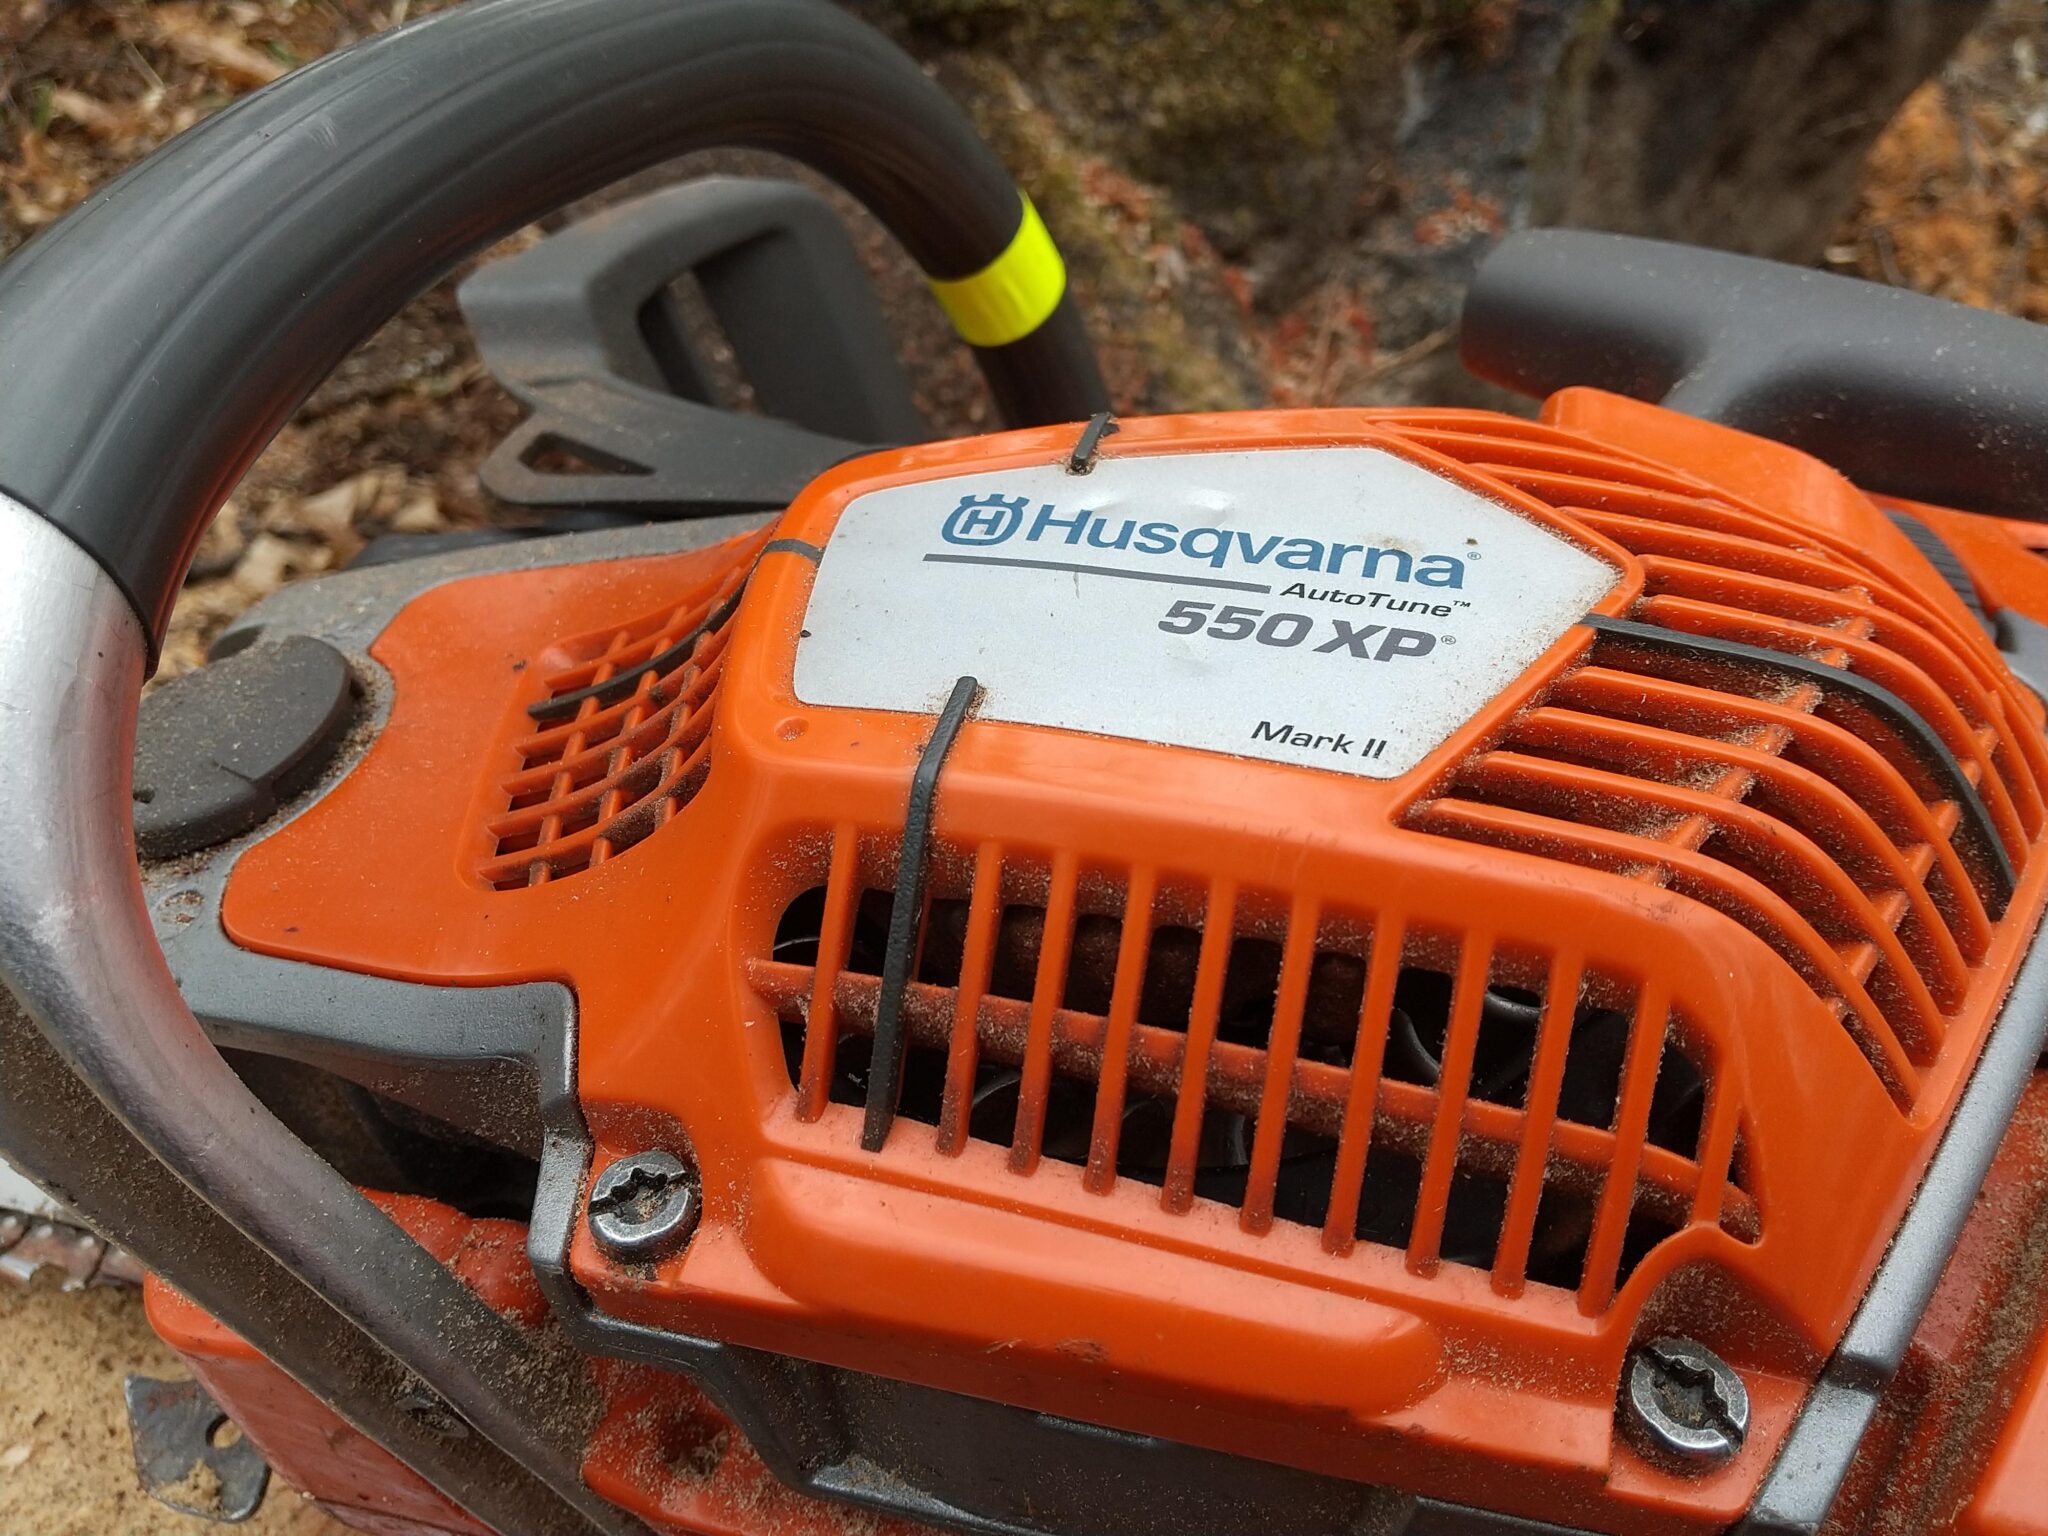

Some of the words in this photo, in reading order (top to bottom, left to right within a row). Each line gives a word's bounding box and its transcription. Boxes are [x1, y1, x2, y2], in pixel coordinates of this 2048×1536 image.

[1157, 599, 1314, 647] 550
[1251, 720, 1354, 756] Mark
[1361, 738, 1388, 760] II
